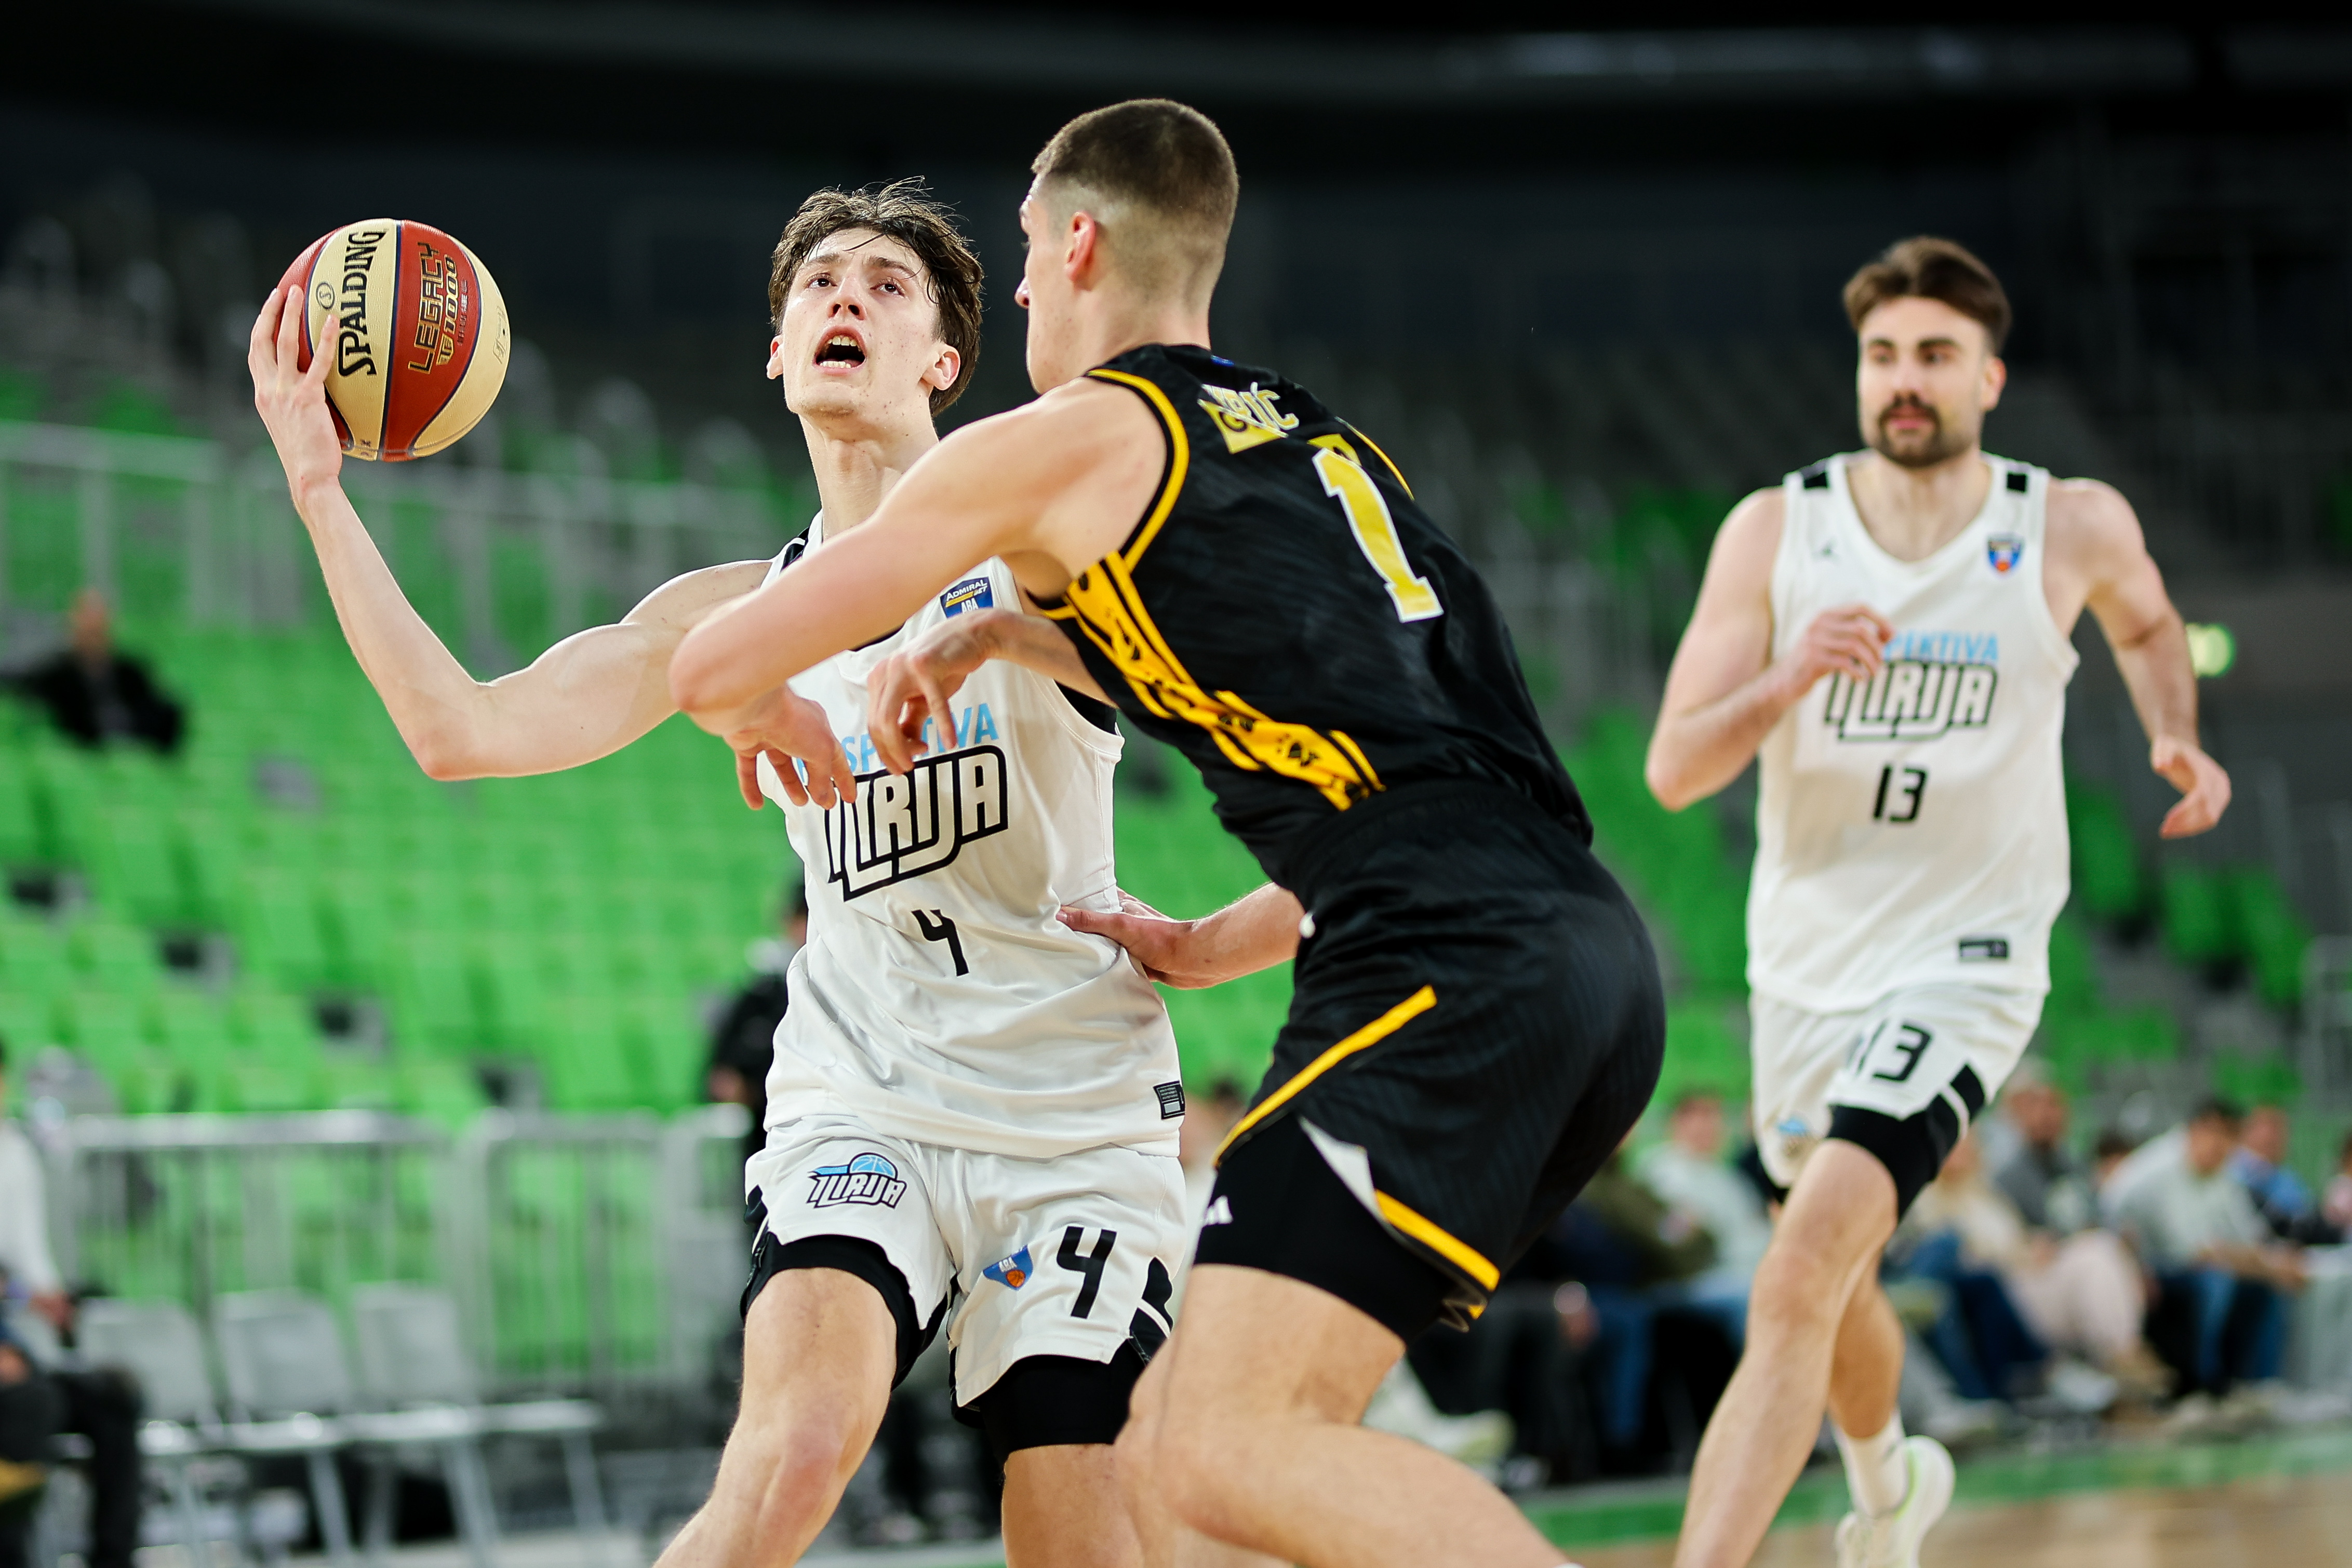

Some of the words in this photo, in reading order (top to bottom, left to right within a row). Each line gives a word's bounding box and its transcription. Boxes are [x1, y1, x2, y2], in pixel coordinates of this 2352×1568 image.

[338, 230, 387, 377] SPALDING
[407, 242, 444, 374] LEGACY
[444, 254, 459, 335] 1000
[1312, 447, 1445, 623] 1
[946, 579, 987, 601] ADMIRAL
[961, 597, 979, 614] ABA
[973, 585, 988, 596] BET
[1824, 658, 1999, 743] ILIRIJA
[1872, 762, 1928, 823] 13
[912, 908, 969, 976] 4
[807, 1172, 907, 1209] ILIRIJA
[1057, 1226, 1117, 1319] 4
